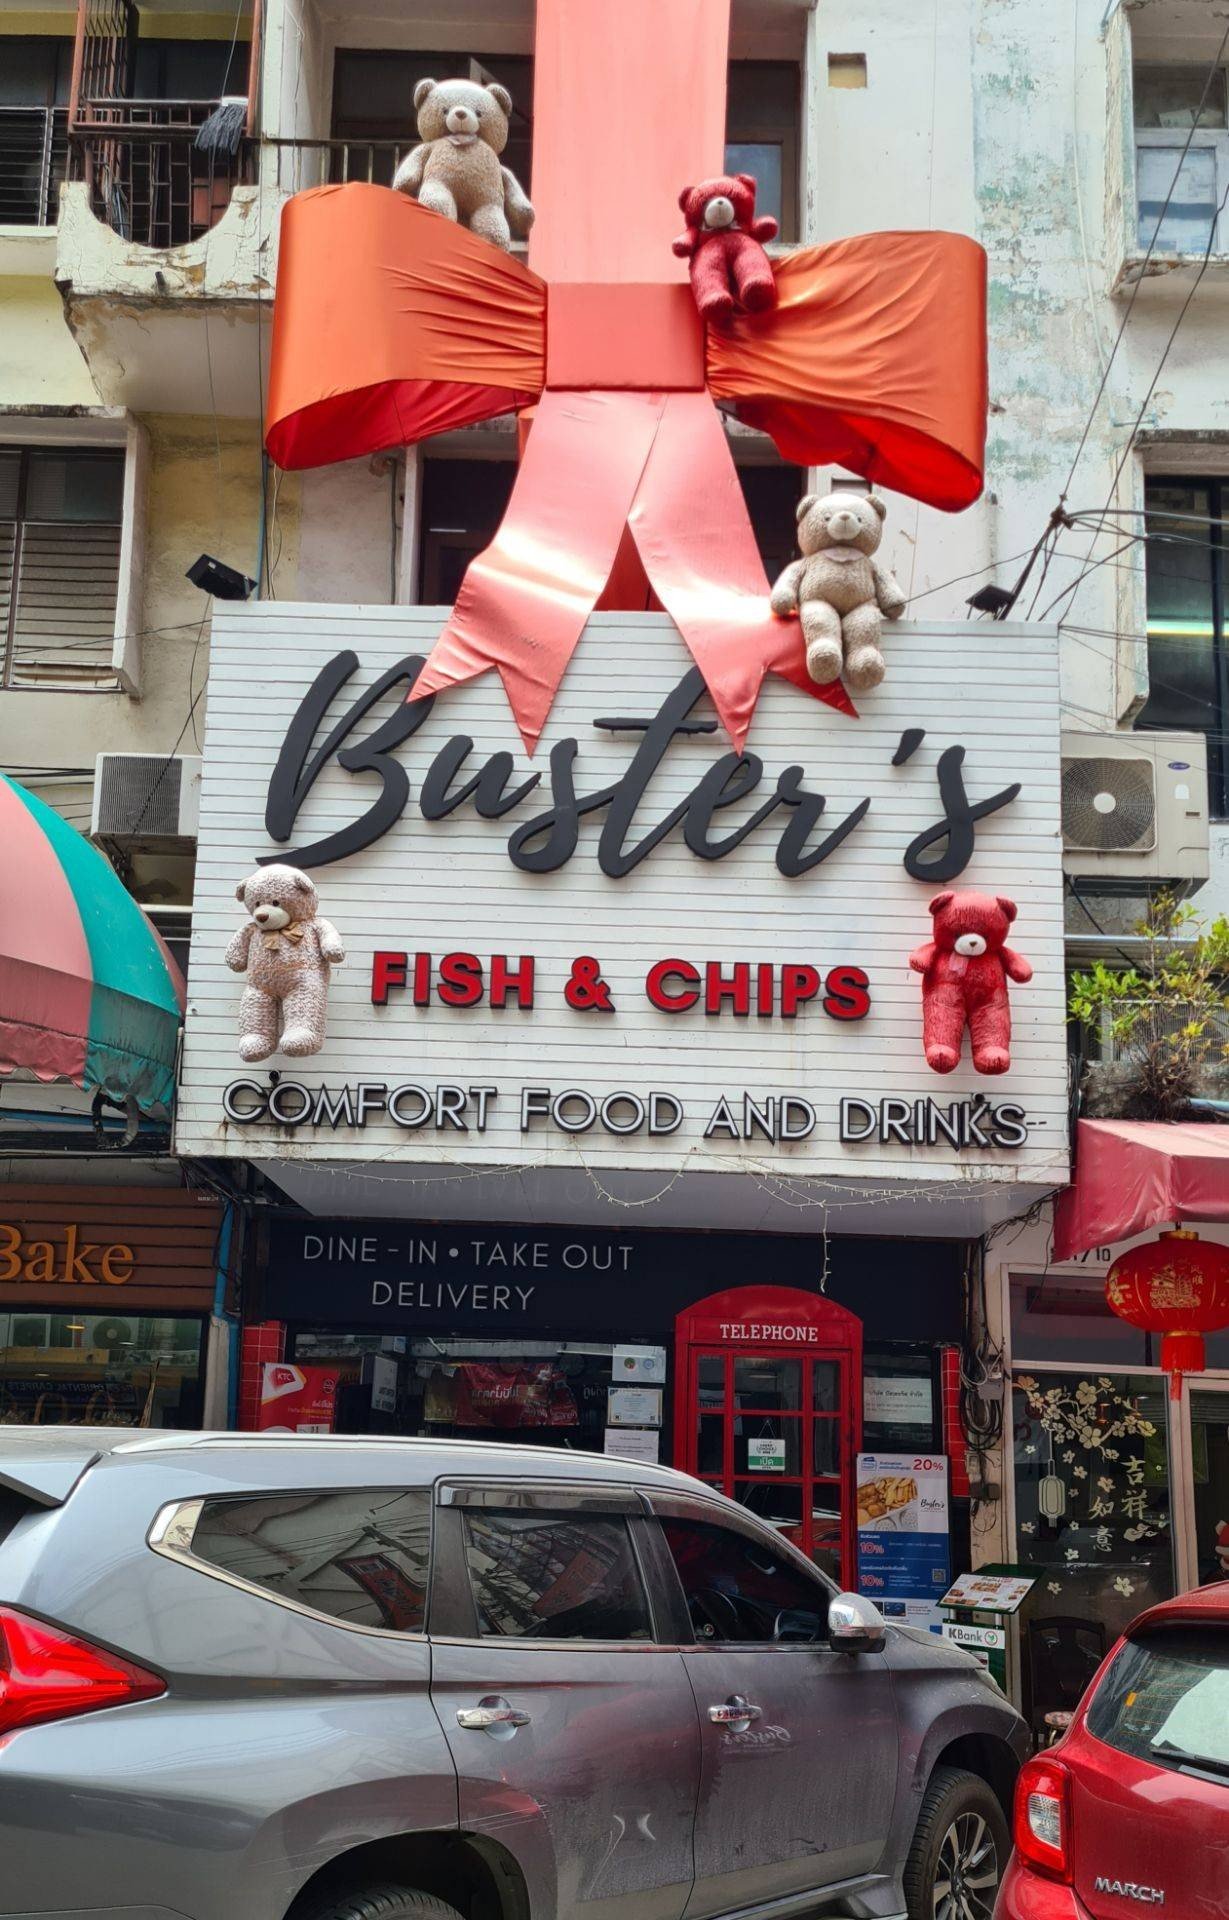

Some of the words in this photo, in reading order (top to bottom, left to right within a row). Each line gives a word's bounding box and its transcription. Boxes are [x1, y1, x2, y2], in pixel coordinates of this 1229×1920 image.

[256, 649, 1021, 883] Buster's
[371, 951, 535, 1010] FISH
[564, 956, 615, 1013] &
[645, 957, 872, 1021] CHIPS
[222, 1076, 498, 1133] COMFORT
[519, 1086, 684, 1136] FOOD
[704, 1091, 817, 1146] AND
[840, 1095, 1029, 1150] DRINKS
[471, 1240, 549, 1268] TAKE
[562, 1244, 634, 1271] OUT
[371, 1281, 536, 1311] DELIVERY
[720, 1323, 819, 1343] TELEPHONE
[277, 1373, 292, 1381] KTC
[913, 1458, 944, 1471] 20%
[1120, 1454, 1149, 1521] 吉祥
[1088, 1495, 1115, 1553] 如意
[860, 1541, 885, 1554] 10%
[860, 1574, 885, 1587] 10%
[948, 1627, 983, 1643] KBank
[1094, 1876, 1165, 1905] MARCH
